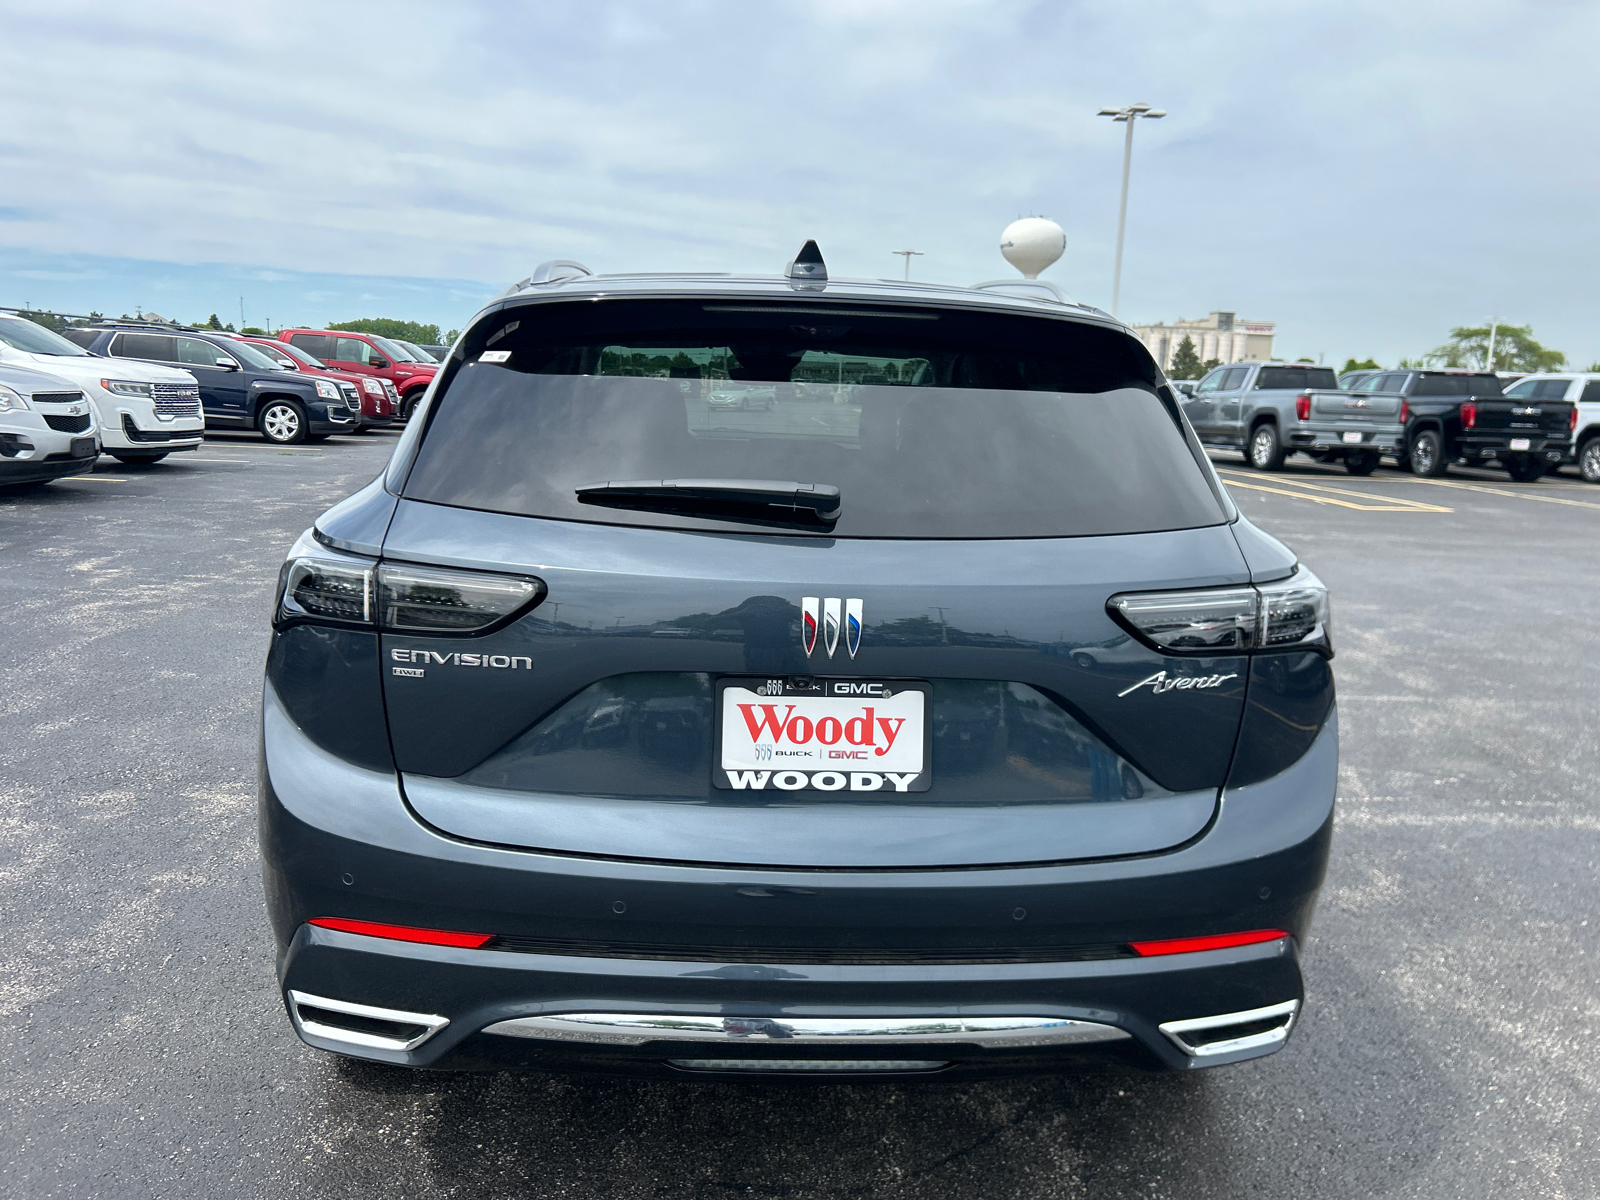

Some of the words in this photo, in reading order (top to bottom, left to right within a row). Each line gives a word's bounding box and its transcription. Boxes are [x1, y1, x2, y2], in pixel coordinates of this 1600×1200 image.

[391, 648, 533, 670] ENVISION
[834, 682, 883, 695] GMC
[1117, 670, 1238, 698] Avenir
[736, 703, 906, 757] Woody
[828, 750, 868, 760] GMC
[725, 770, 919, 792] WOODY
